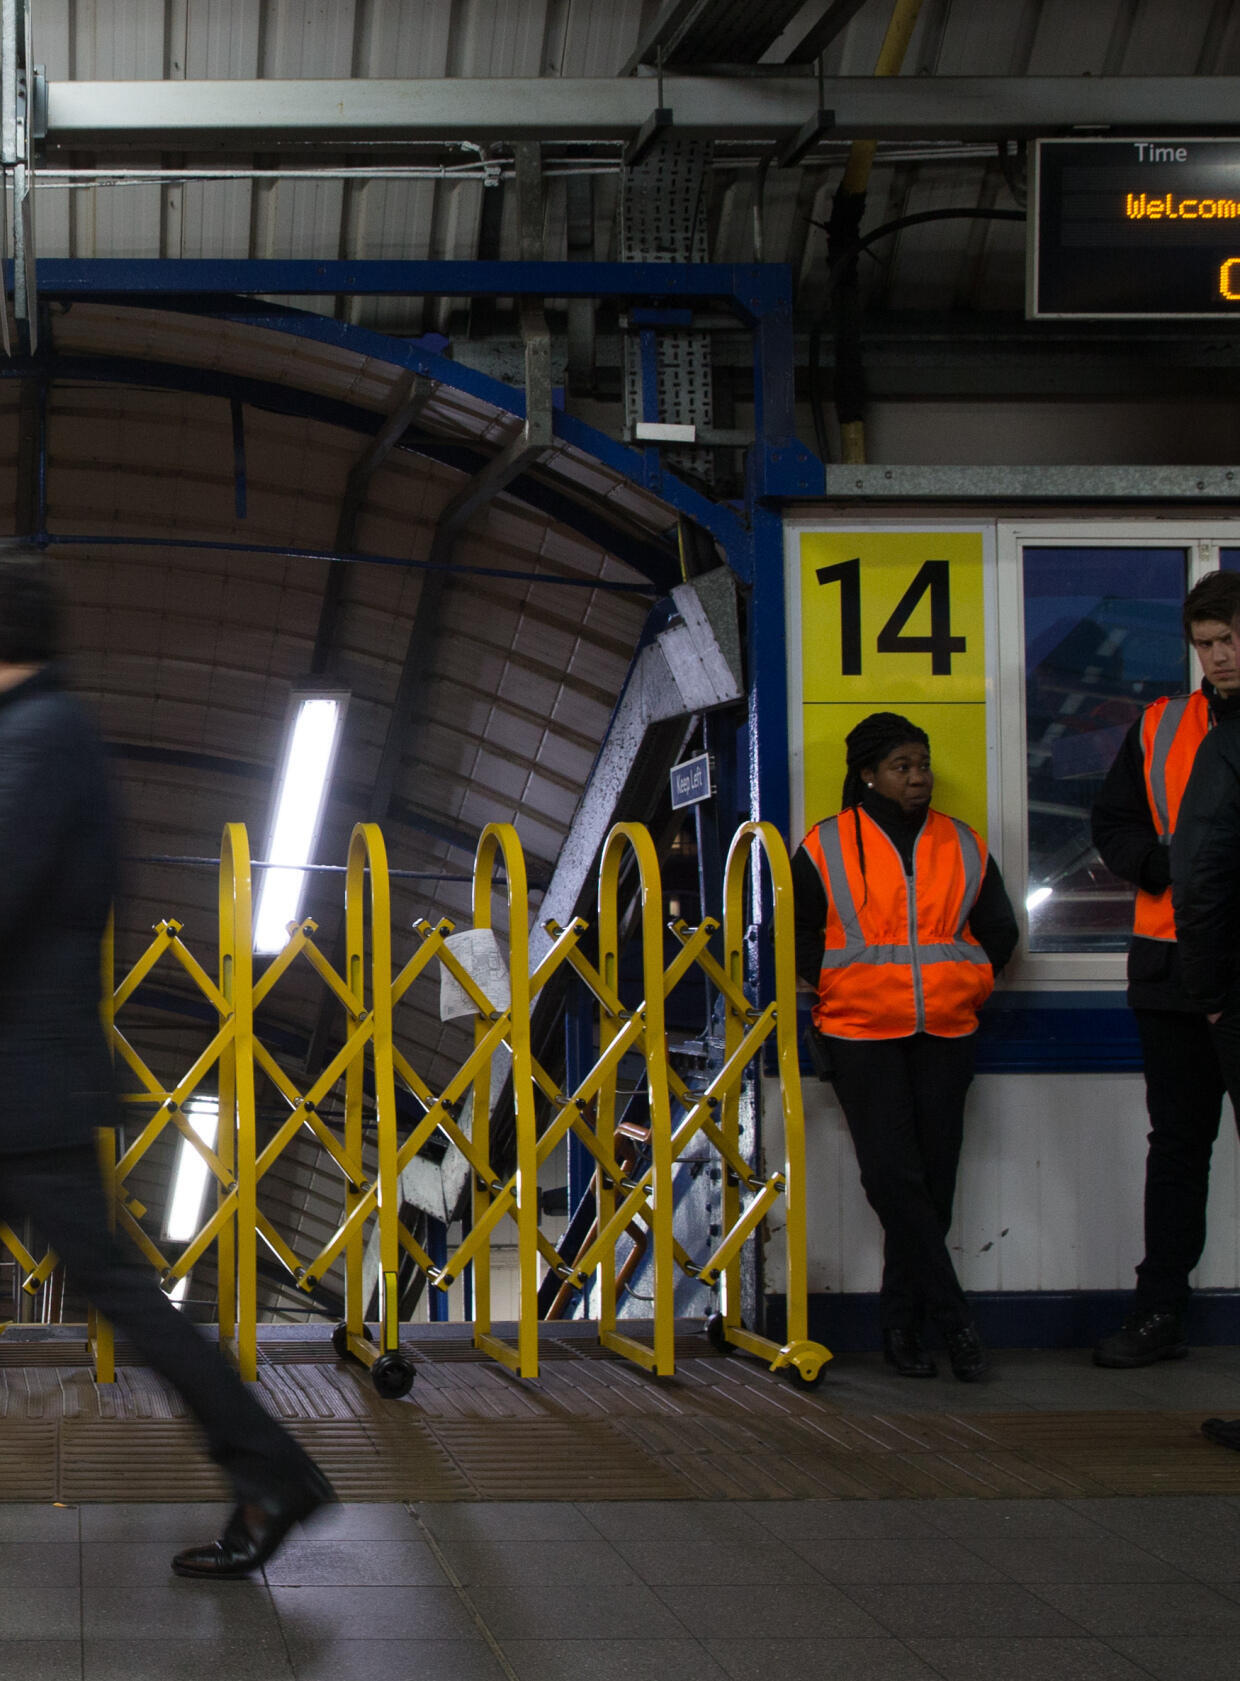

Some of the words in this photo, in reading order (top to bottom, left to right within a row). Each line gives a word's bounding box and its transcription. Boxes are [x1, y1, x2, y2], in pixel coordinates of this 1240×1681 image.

[1134, 142, 1188, 162] Time
[1126, 193, 1240, 219] Welcom
[815, 557, 967, 676] 14
[676, 773, 691, 796] Keep
[690, 766, 703, 790] Left
